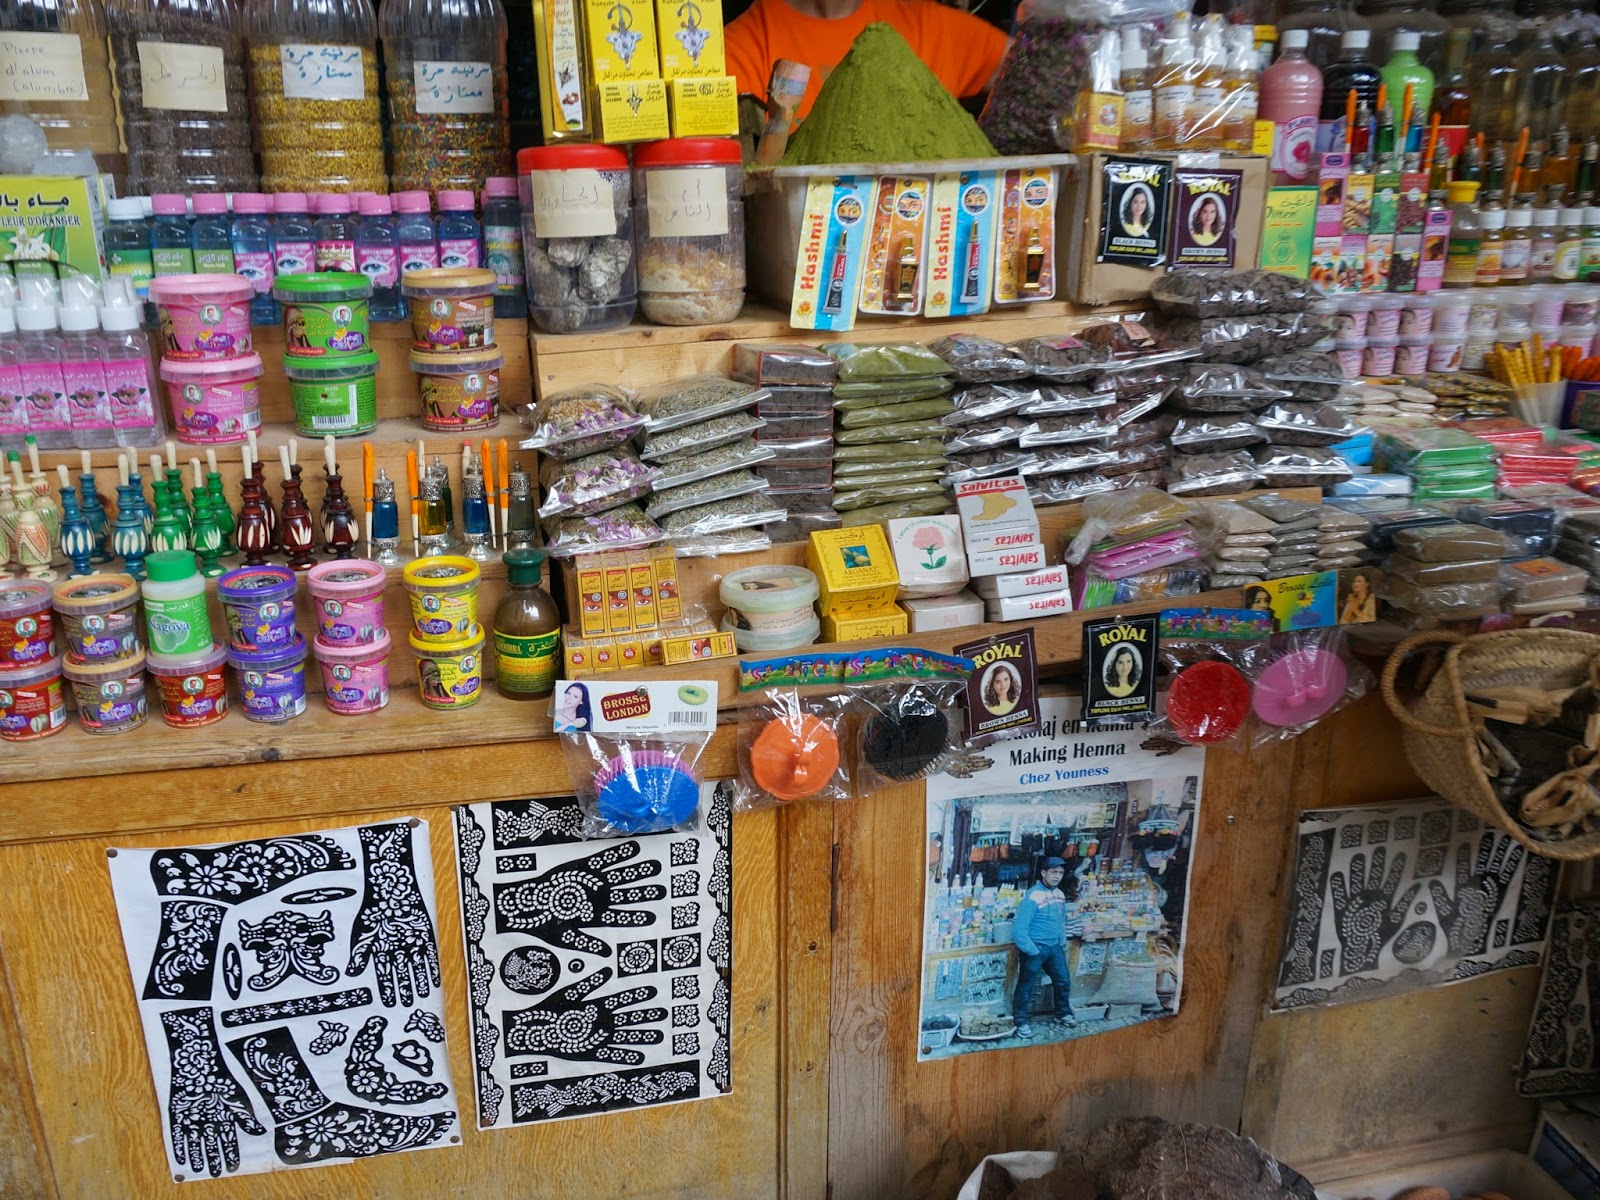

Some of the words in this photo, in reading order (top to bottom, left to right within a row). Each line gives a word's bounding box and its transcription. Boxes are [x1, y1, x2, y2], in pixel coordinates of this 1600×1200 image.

[27, 215, 80, 226] D'ORANGER
[933, 206, 951, 280] Hashmi
[800, 213, 824, 290] Hashmi
[960, 478, 1019, 493] Salvitas
[995, 533, 1034, 546] Salvitas
[999, 552, 1039, 566] Salvitas
[1025, 572, 1062, 586] Salvitas
[1029, 598, 1066, 610] Salvitas
[148, 619, 190, 634] Nagoya
[1098, 624, 1147, 647] ROYAL
[972, 643, 1022, 669] ROYAL
[603, 695, 647, 710] BROSSE
[1120, 697, 1143, 705] HENNA
[606, 703, 649, 720] LONDON
[981, 718, 1004, 728] BROWN
[1005, 710, 1027, 721] HENNA
[1010, 746, 1067, 767] Making
[1073, 742, 1126, 759] Henna
[1020, 772, 1051, 786] Chez
[1055, 766, 1110, 781] Youness
